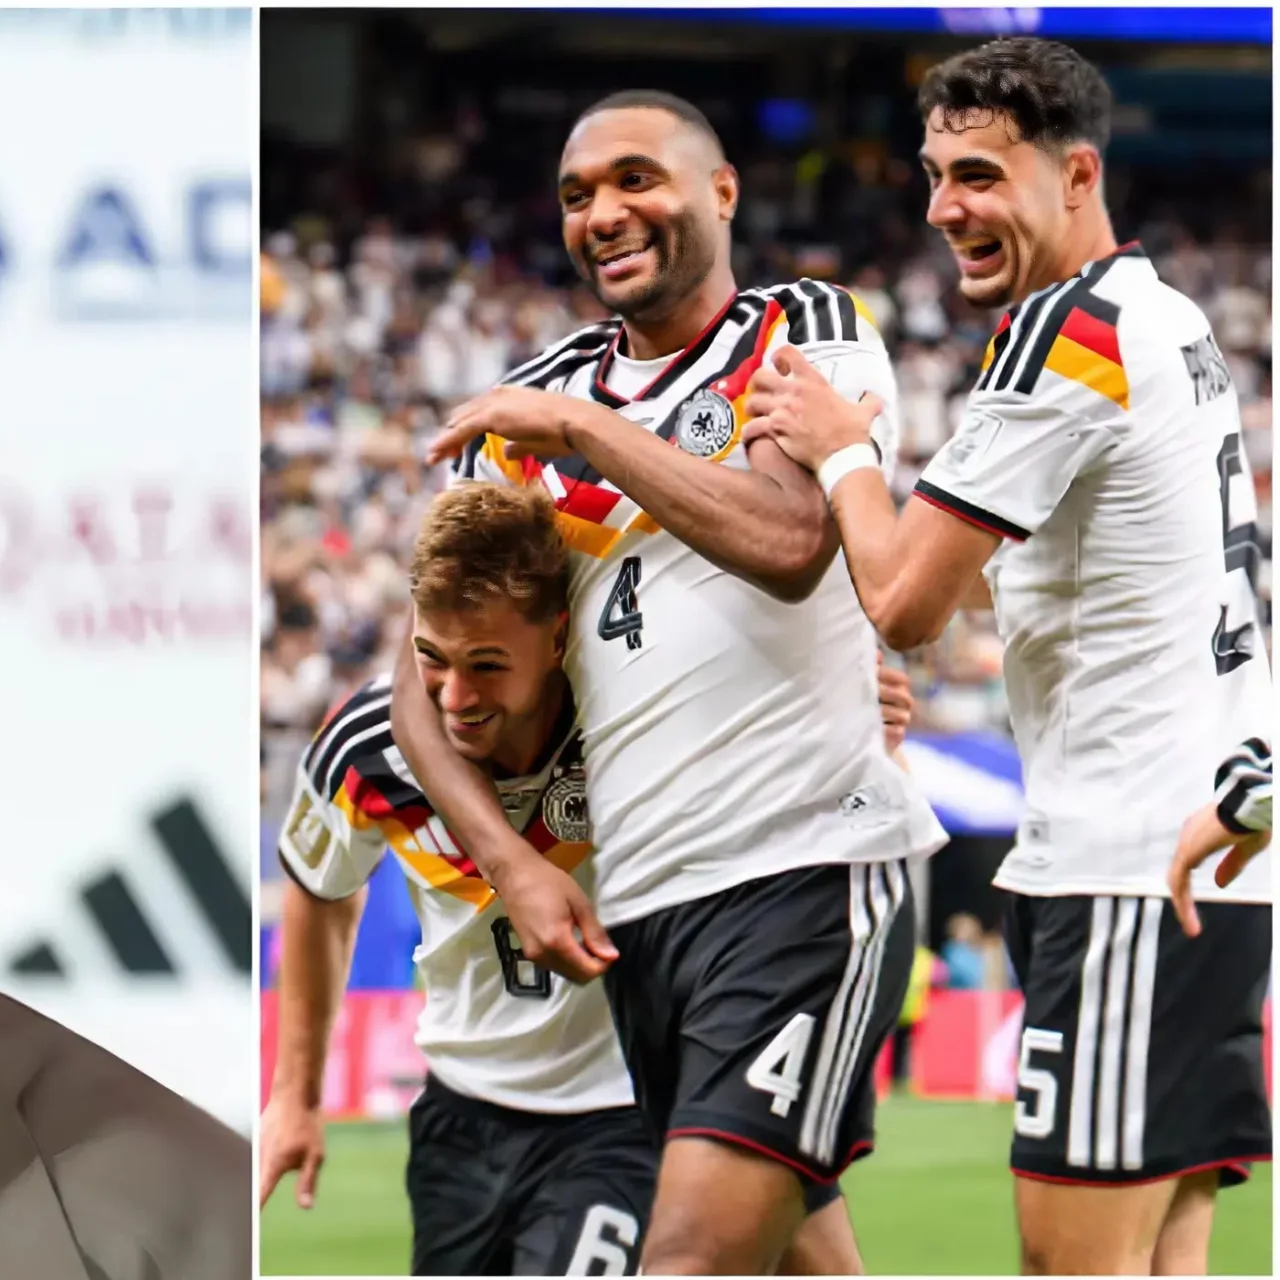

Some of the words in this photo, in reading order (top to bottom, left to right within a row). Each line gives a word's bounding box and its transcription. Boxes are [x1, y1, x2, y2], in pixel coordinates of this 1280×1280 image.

[598, 556, 643, 651] 4
[746, 1012, 817, 1118] 4
[1016, 1026, 1064, 1137] 5
[565, 1204, 639, 1276] 6
